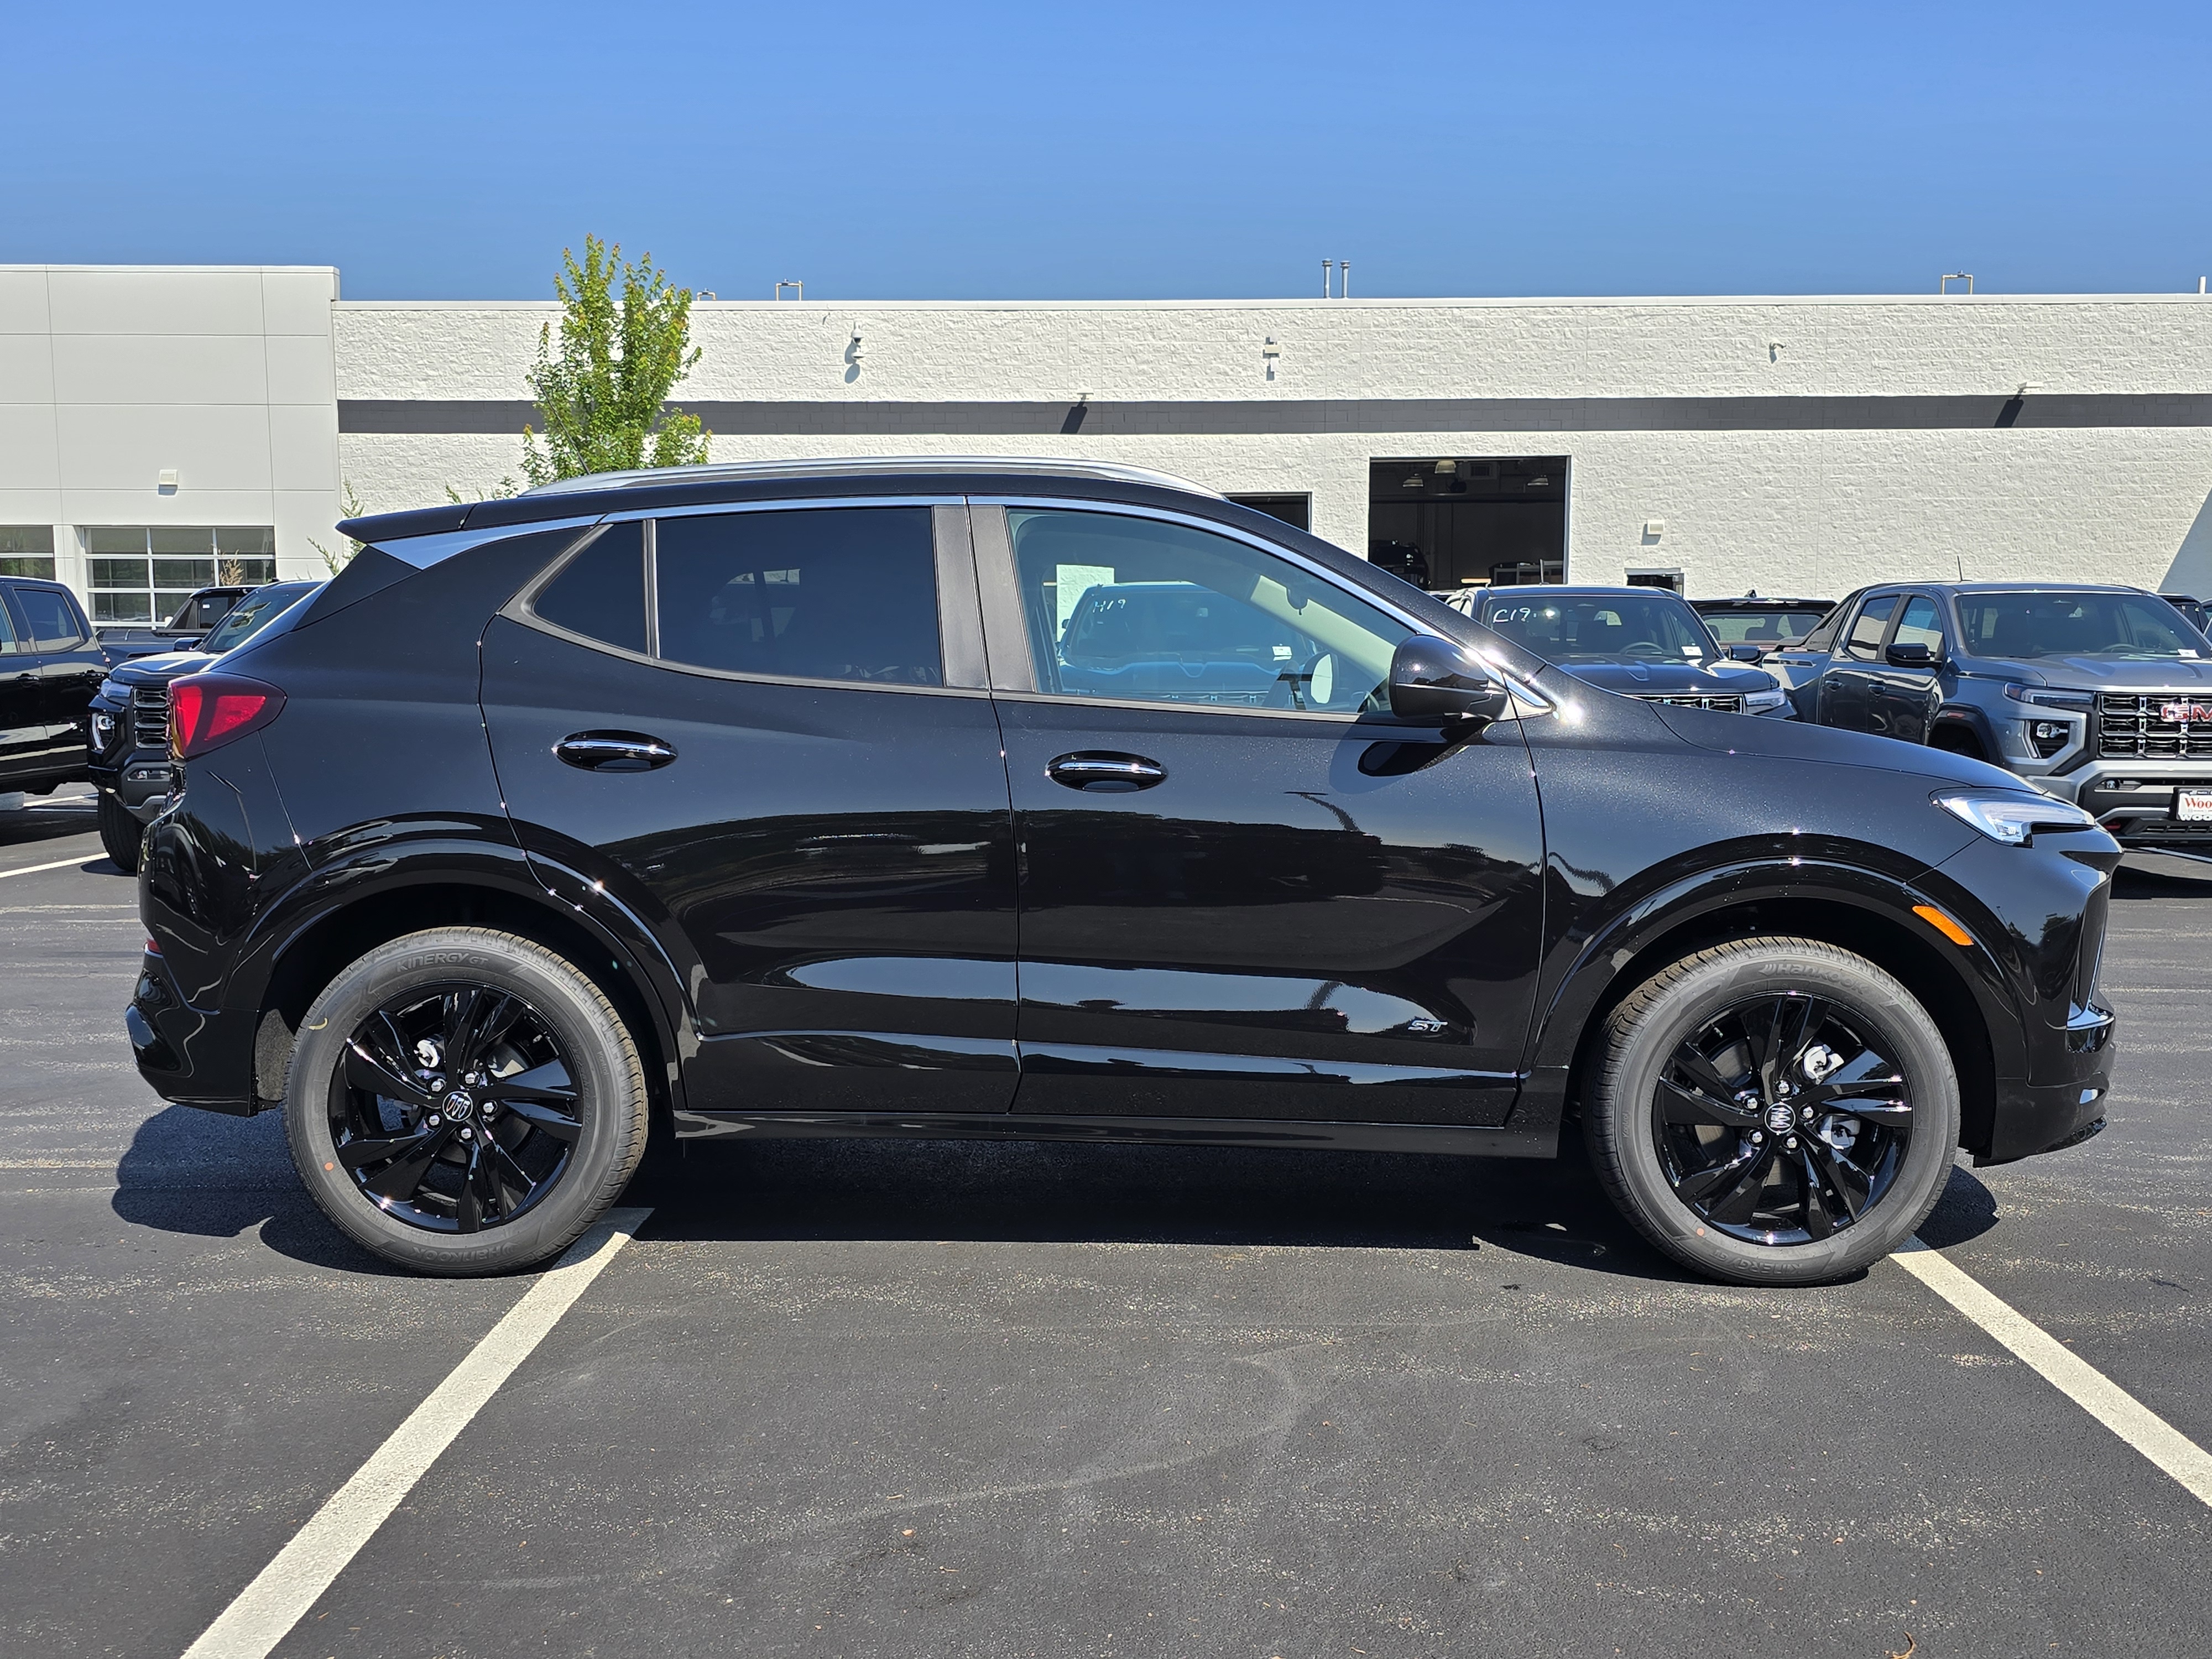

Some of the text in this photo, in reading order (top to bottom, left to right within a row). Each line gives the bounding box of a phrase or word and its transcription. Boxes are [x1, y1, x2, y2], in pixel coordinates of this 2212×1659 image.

[1093, 599, 1126, 613] H19
[1493, 608, 1531, 623] C19
[397, 952, 488, 972] KINERGY GT
[1777, 963, 1870, 994] Hankook
[1408, 1020, 1448, 1032] ST
[597, 1051, 609, 1076] Kontrol
[413, 1245, 500, 1262] Hankook
[1728, 1257, 1803, 1275] KINERGY
